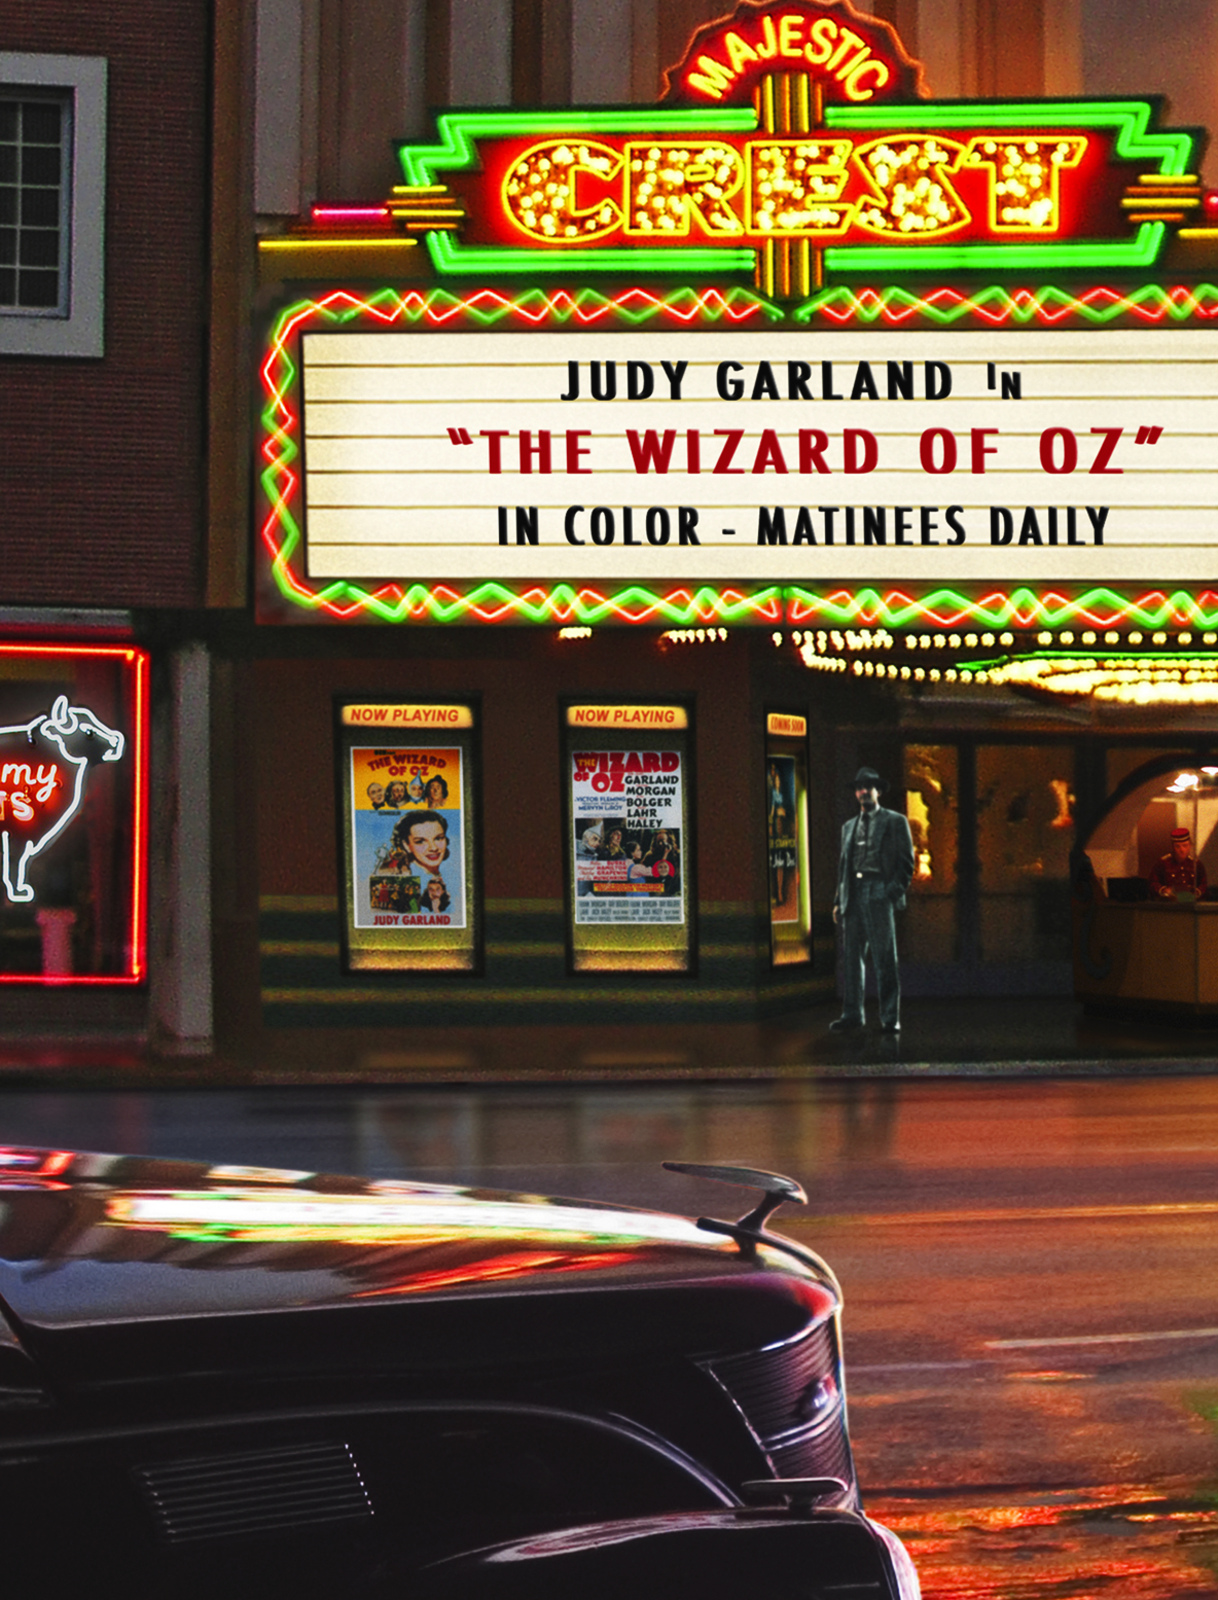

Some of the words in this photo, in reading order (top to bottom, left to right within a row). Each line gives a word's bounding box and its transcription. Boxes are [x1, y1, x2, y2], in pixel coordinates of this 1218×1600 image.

[688, 14, 892, 101] MAJESTIC
[501, 133, 1088, 242] CREST
[560, 360, 689, 401] JUDY
[716, 360, 953, 401] GARLAND
[446, 427, 593, 475] "THE
[626, 428, 879, 475] WIZARD
[918, 427, 999, 475] OF
[1038, 426, 1163, 475] OZ"
[497, 505, 540, 547] IN
[564, 505, 702, 547] COLOR
[756, 505, 967, 547] MATINEES
[989, 505, 1111, 547] DAILY
[350, 708, 389, 721] NOW
[392, 709, 459, 722] PLAYING
[574, 709, 610, 722] NOW
[613, 710, 676, 723] PLAYING
[367, 756, 392, 771] THE
[393, 753, 447, 769] WIZARD
[572, 751, 680, 773] WIZARD
[388, 765, 407, 776] OF
[410, 765, 429, 776] OZ
[573, 771, 590, 782] OF
[591, 771, 625, 793] OZ
[624, 775, 679, 785] GARLAND
[625, 786, 676, 796] MORGAN
[626, 797, 672, 807] BOLGER
[627, 808, 657, 818] LAHR
[627, 819, 663, 828] HALEY
[373, 915, 400, 926] JUDY
[402, 915, 451, 926] GARLAND
